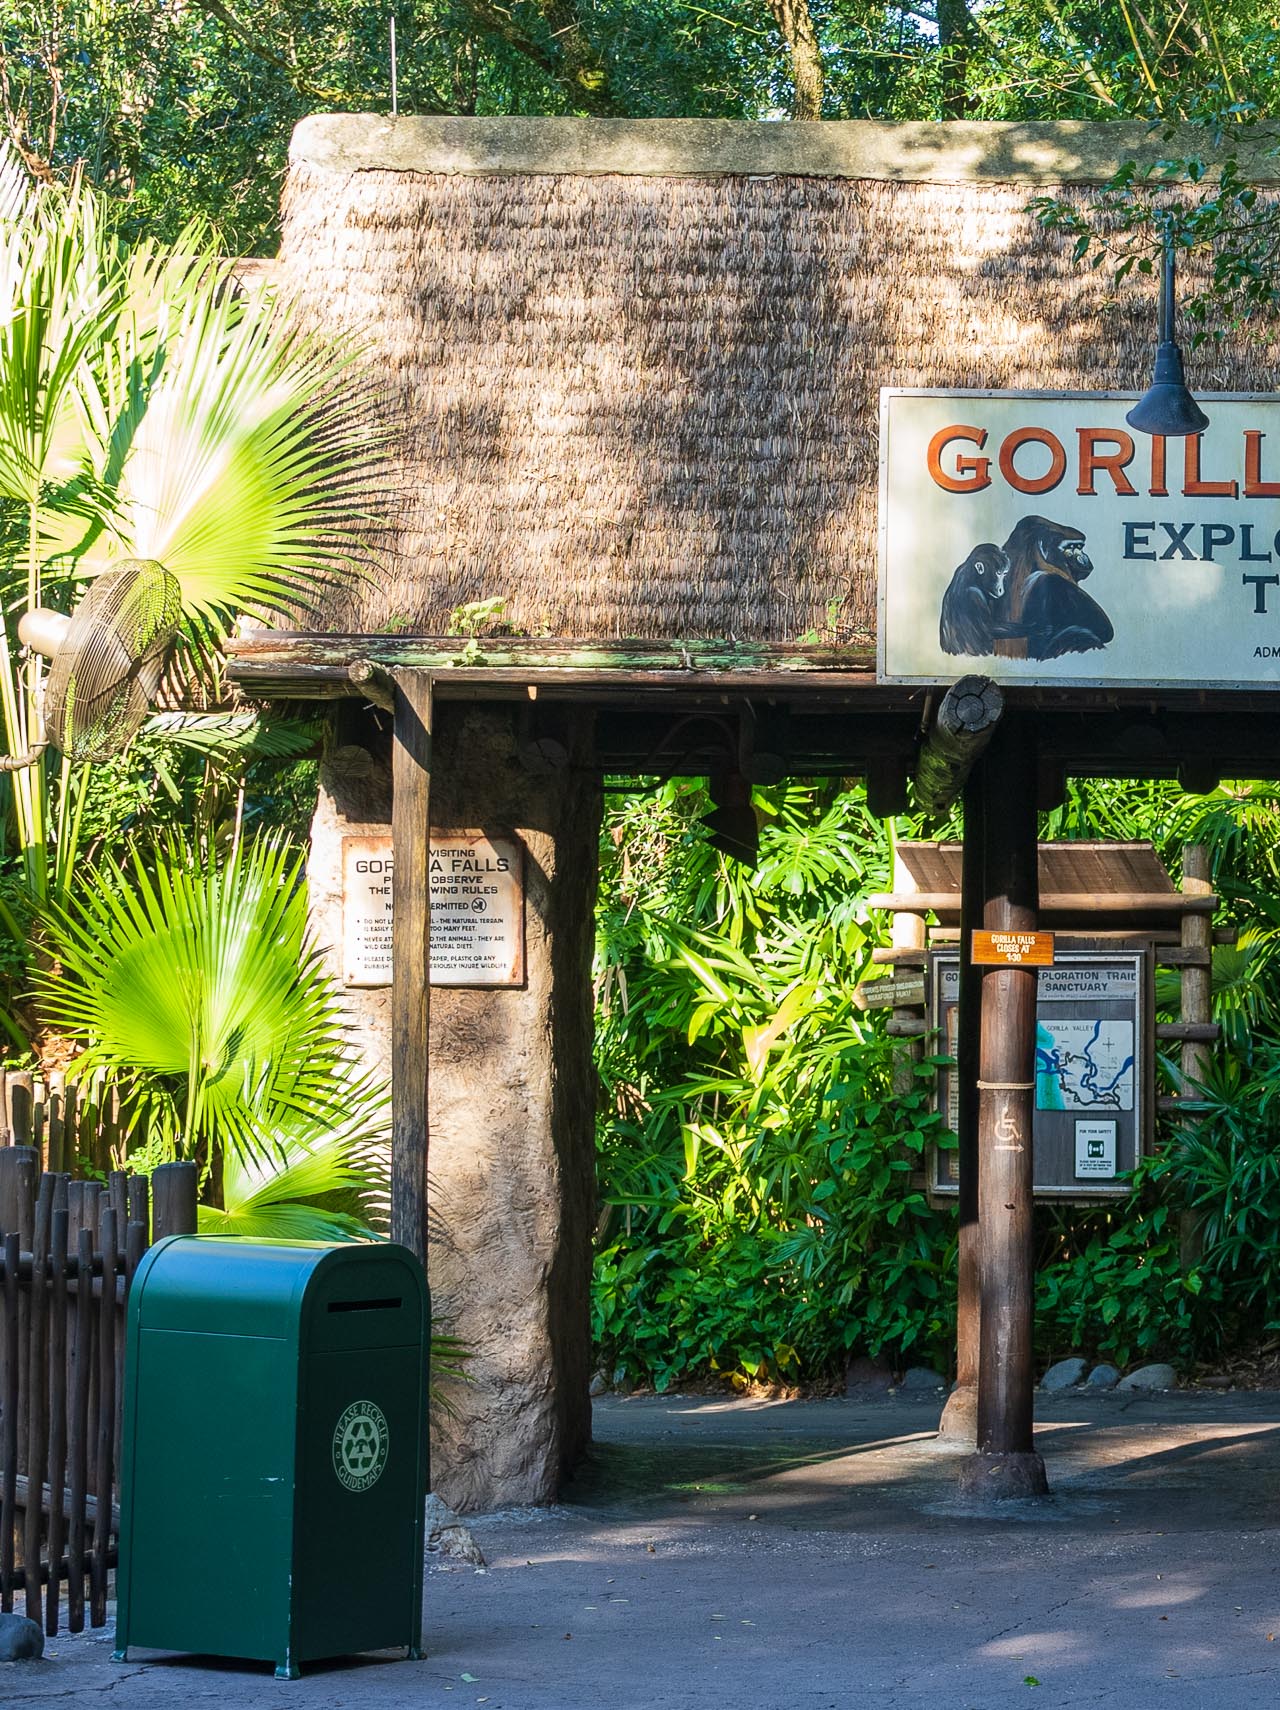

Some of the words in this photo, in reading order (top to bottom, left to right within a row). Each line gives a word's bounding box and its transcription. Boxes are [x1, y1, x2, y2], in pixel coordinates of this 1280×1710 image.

[429, 849, 476, 858] VISITING
[356, 859, 443, 873] GORA
[452, 858, 509, 873] FALLS
[431, 875, 484, 884] OBSERVE
[368, 886, 391, 895] THE
[462, 886, 498, 895] RULES
[429, 902, 469, 911] ERMITTED
[991, 934, 1016, 944] GORILLA
[1017, 935, 1036, 945] FALLS
[996, 943, 1019, 953] CLOSES
[1020, 944, 1031, 954] AT
[1045, 982, 1108, 992] SANCTUARY
[335, 1405, 360, 1445] PLEASE
[361, 1403, 388, 1442] RECYCLE
[338, 1462, 382, 1490] GUIDEMAPS
